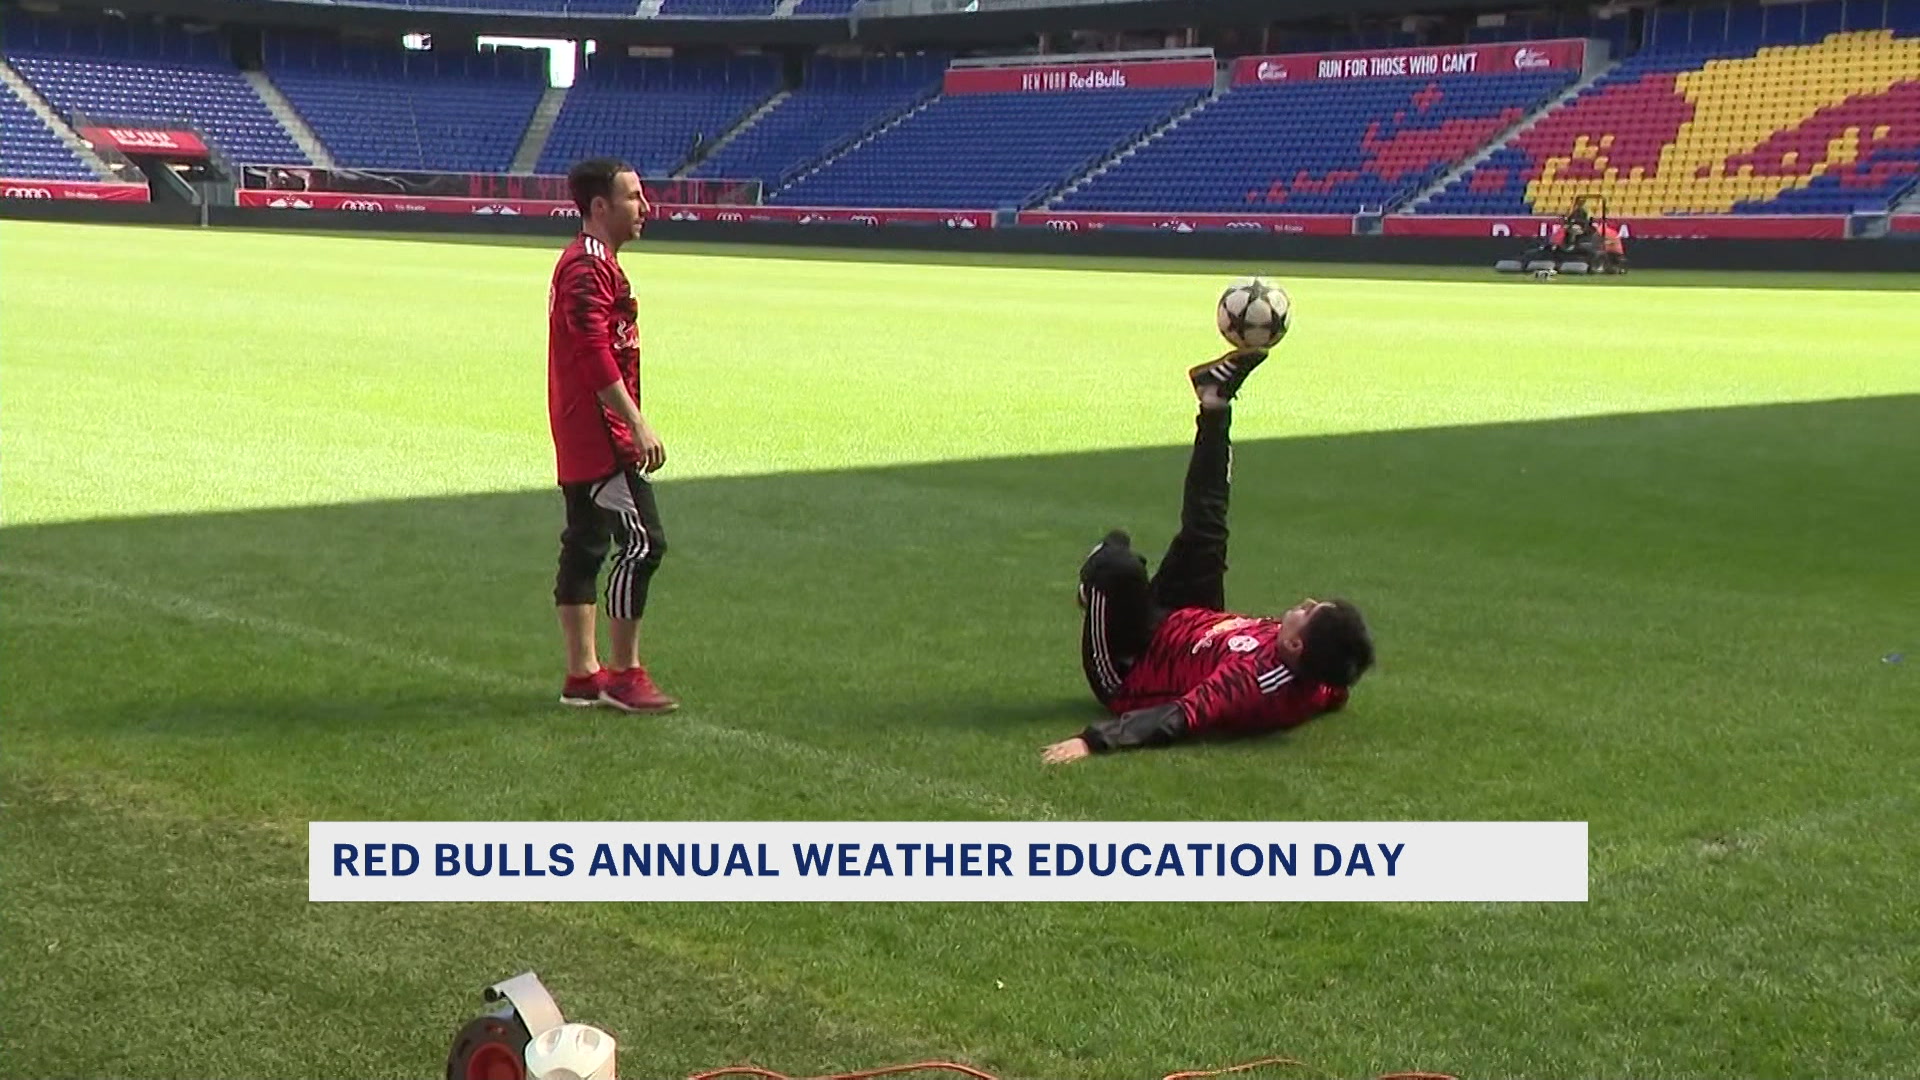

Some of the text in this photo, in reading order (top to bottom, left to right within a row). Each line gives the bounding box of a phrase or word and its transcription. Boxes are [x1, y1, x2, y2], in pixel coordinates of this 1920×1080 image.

[1319, 52, 1478, 78] RUN FOR THOSE WHO CAN'T
[1022, 69, 1126, 91] NEW YORK Red Bulls
